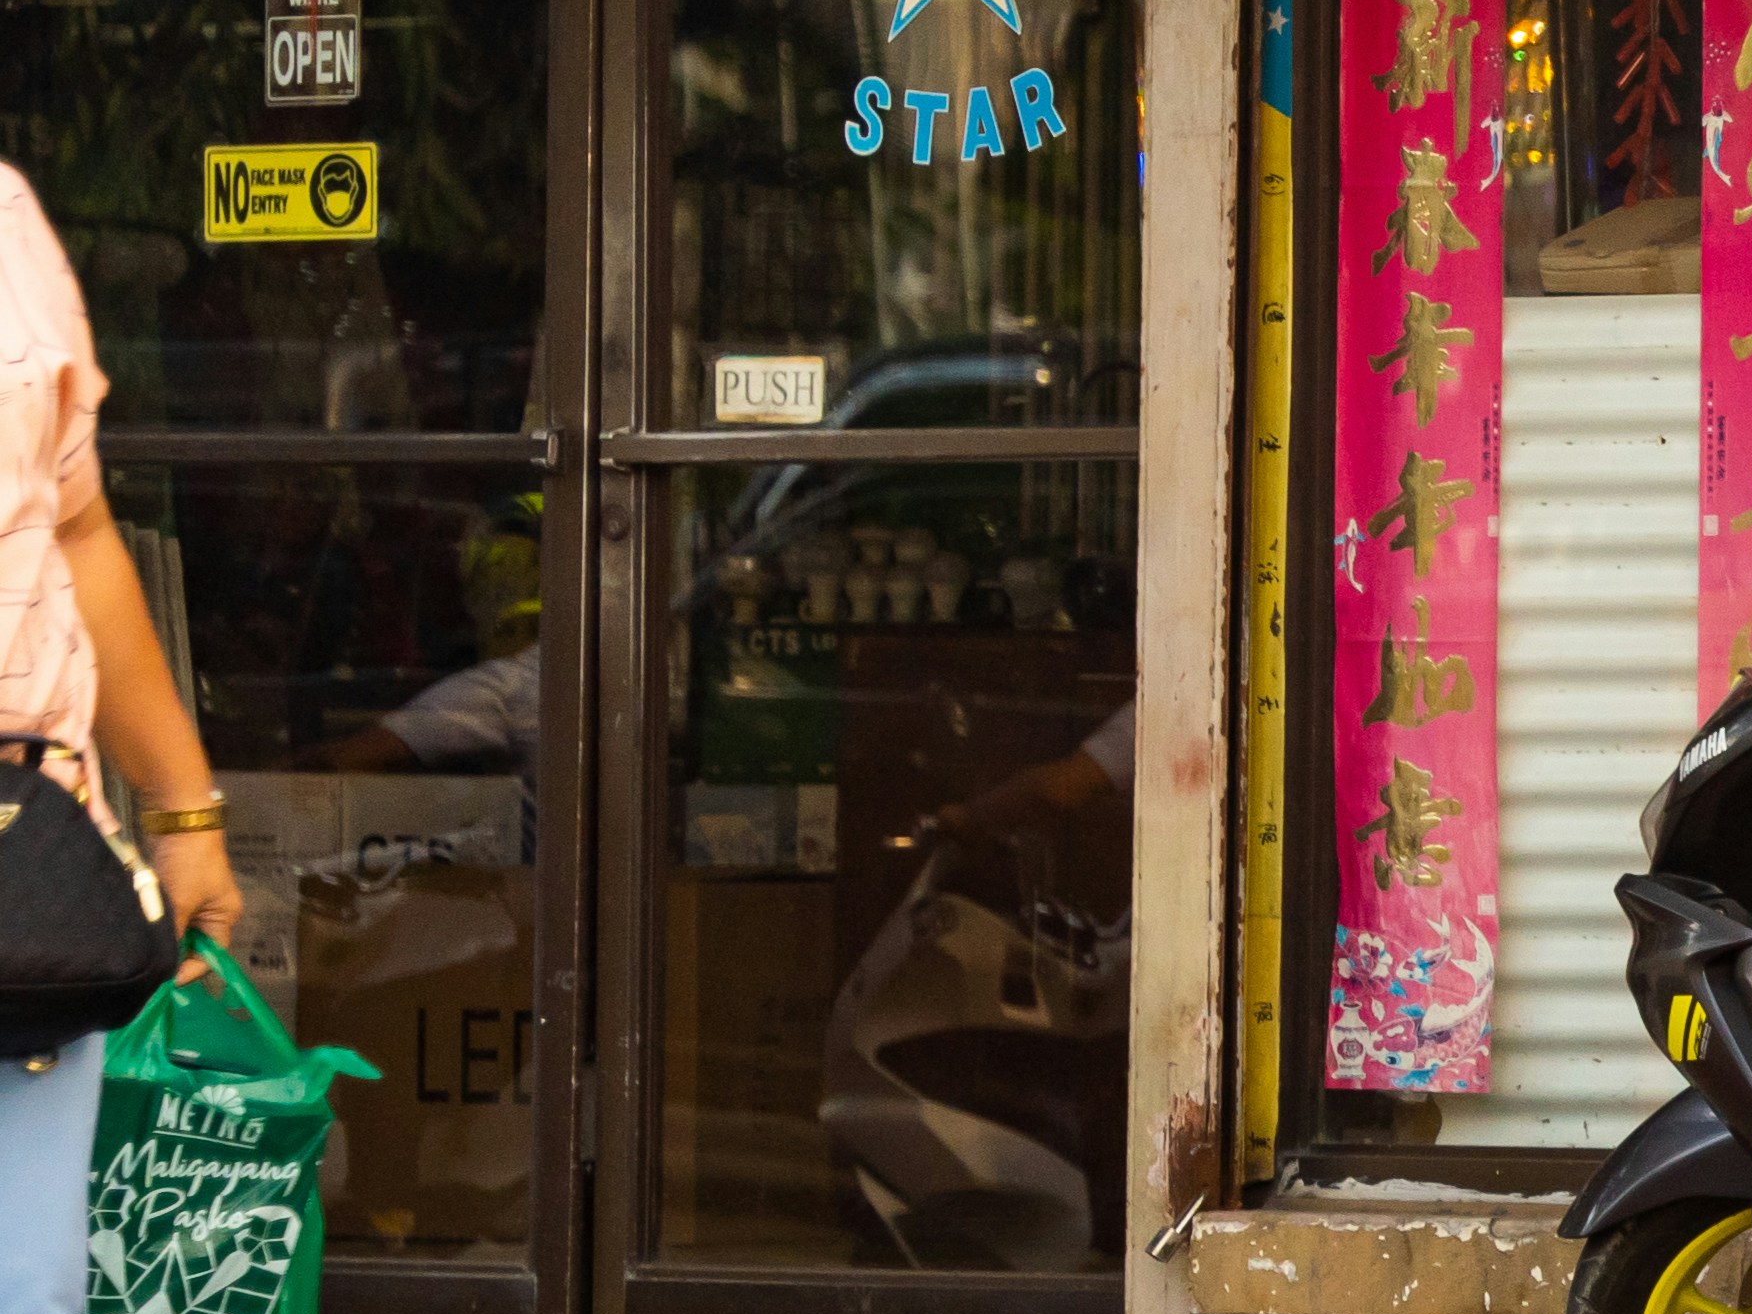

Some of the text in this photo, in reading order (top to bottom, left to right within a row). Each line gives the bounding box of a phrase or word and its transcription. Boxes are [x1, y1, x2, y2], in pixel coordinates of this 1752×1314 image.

[272, 29, 355, 87] OPEN
[844, 67, 1067, 167] STAR
[213, 160, 250, 225] NO
[251, 168, 275, 186] FACE
[251, 194, 289, 215] ENTRY
[721, 371, 818, 408] PUSH
[1679, 726, 1728, 782] YAMAHA
[102, 1138, 301, 1197] Maligayang
[135, 1187, 256, 1242] Pasko
